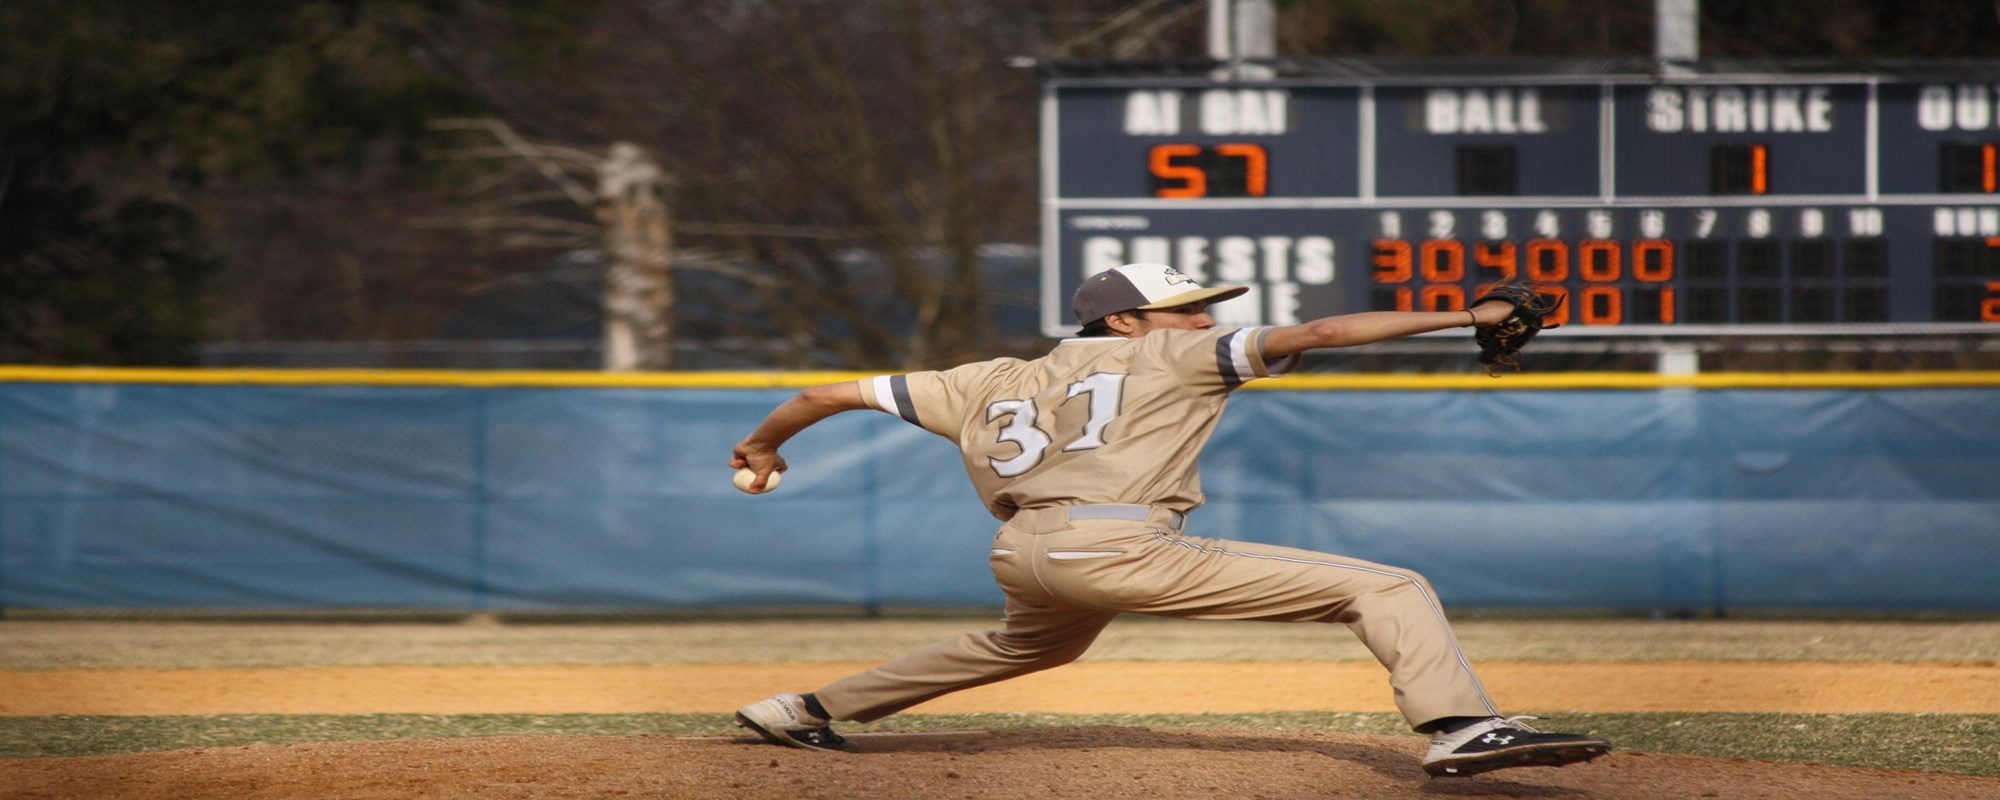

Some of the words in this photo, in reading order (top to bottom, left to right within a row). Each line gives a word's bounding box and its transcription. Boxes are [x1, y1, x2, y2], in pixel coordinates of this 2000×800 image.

[1425, 88, 1547, 133] BALL
[1647, 88, 1832, 133] STRIKE
[1918, 86, 2000, 131] OU
[1148, 143, 1268, 199] 57
[1750, 144, 1768, 195] 1
[1380, 210, 1400, 238] 1
[1429, 210, 1456, 238] 2
[1481, 210, 1507, 239] 3
[1535, 210, 1560, 238] 4
[1587, 210, 1613, 238] 5
[1640, 209, 1665, 238] 6
[1697, 209, 1717, 238] 7
[1747, 209, 1771, 238] 8
[1802, 209, 1824, 237] 9
[1849, 208, 1882, 237] 10
[1083, 236, 1335, 285] GUESTS
